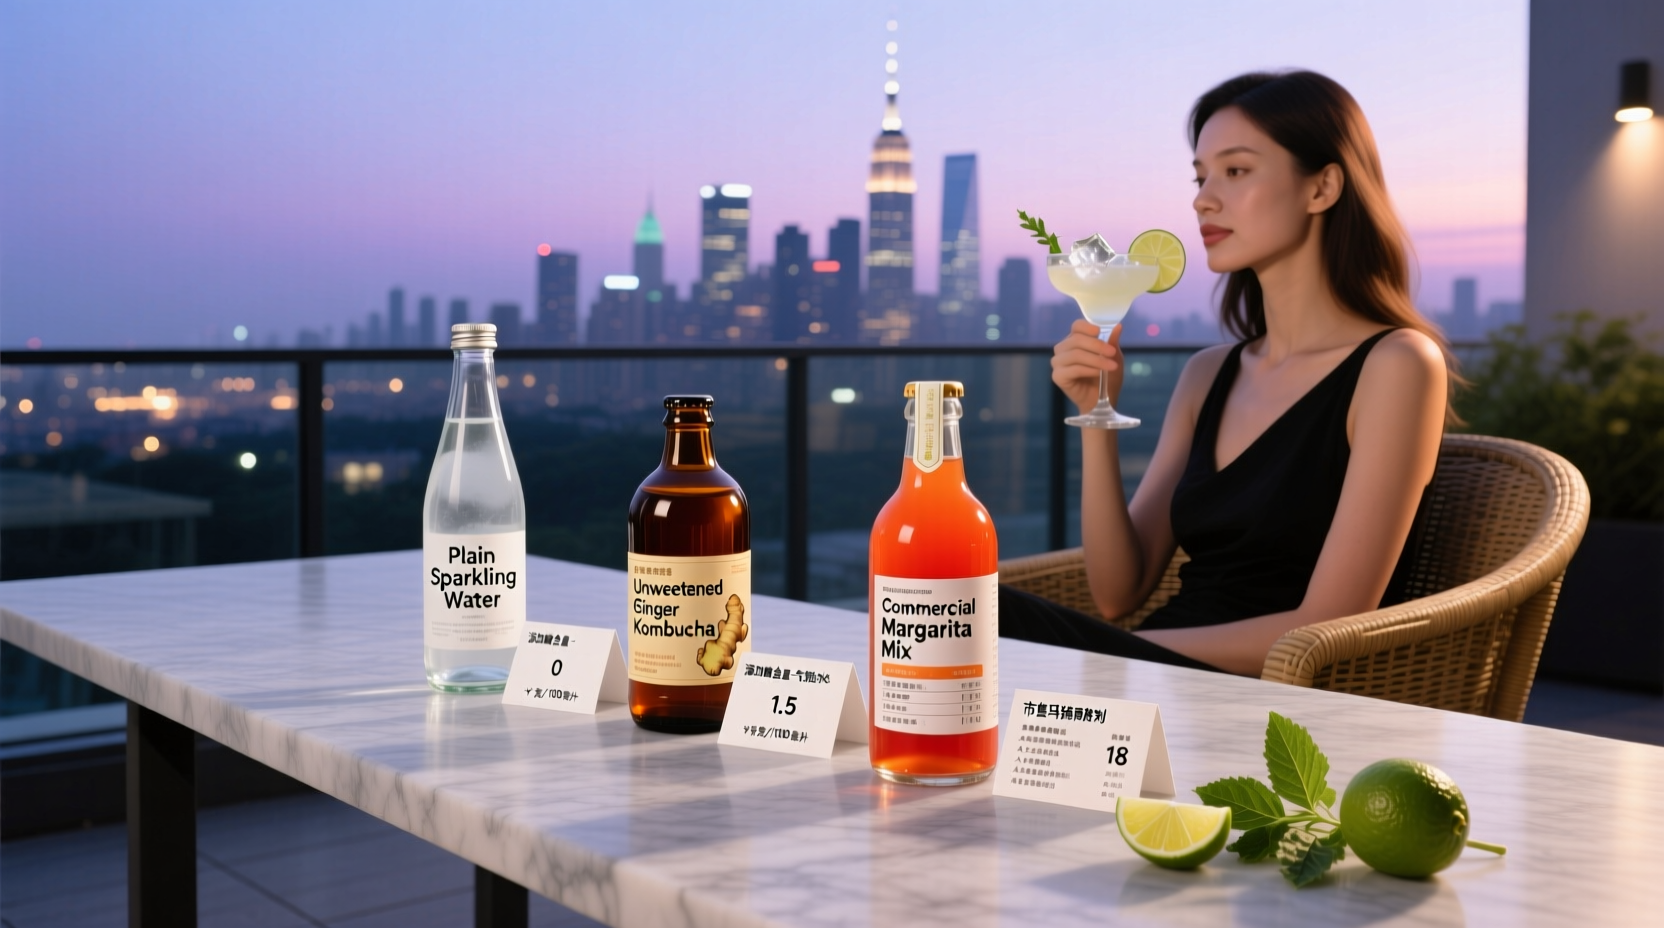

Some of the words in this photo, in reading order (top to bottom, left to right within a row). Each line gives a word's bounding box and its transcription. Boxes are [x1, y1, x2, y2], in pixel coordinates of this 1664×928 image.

[449, 545, 495, 565] Plain
[431, 567, 516, 591] Sparkling
[444, 591, 501, 609] Water
[633, 598, 680, 620] Ginger
[882, 597, 976, 617] Commercial
[633, 617, 716, 637] Kombucha
[882, 617, 972, 643] Margarita
[882, 640, 912, 660] Mix
[551, 659, 563, 676] 0
[771, 695, 798, 716] 1.5
[1106, 745, 1129, 766] 18
